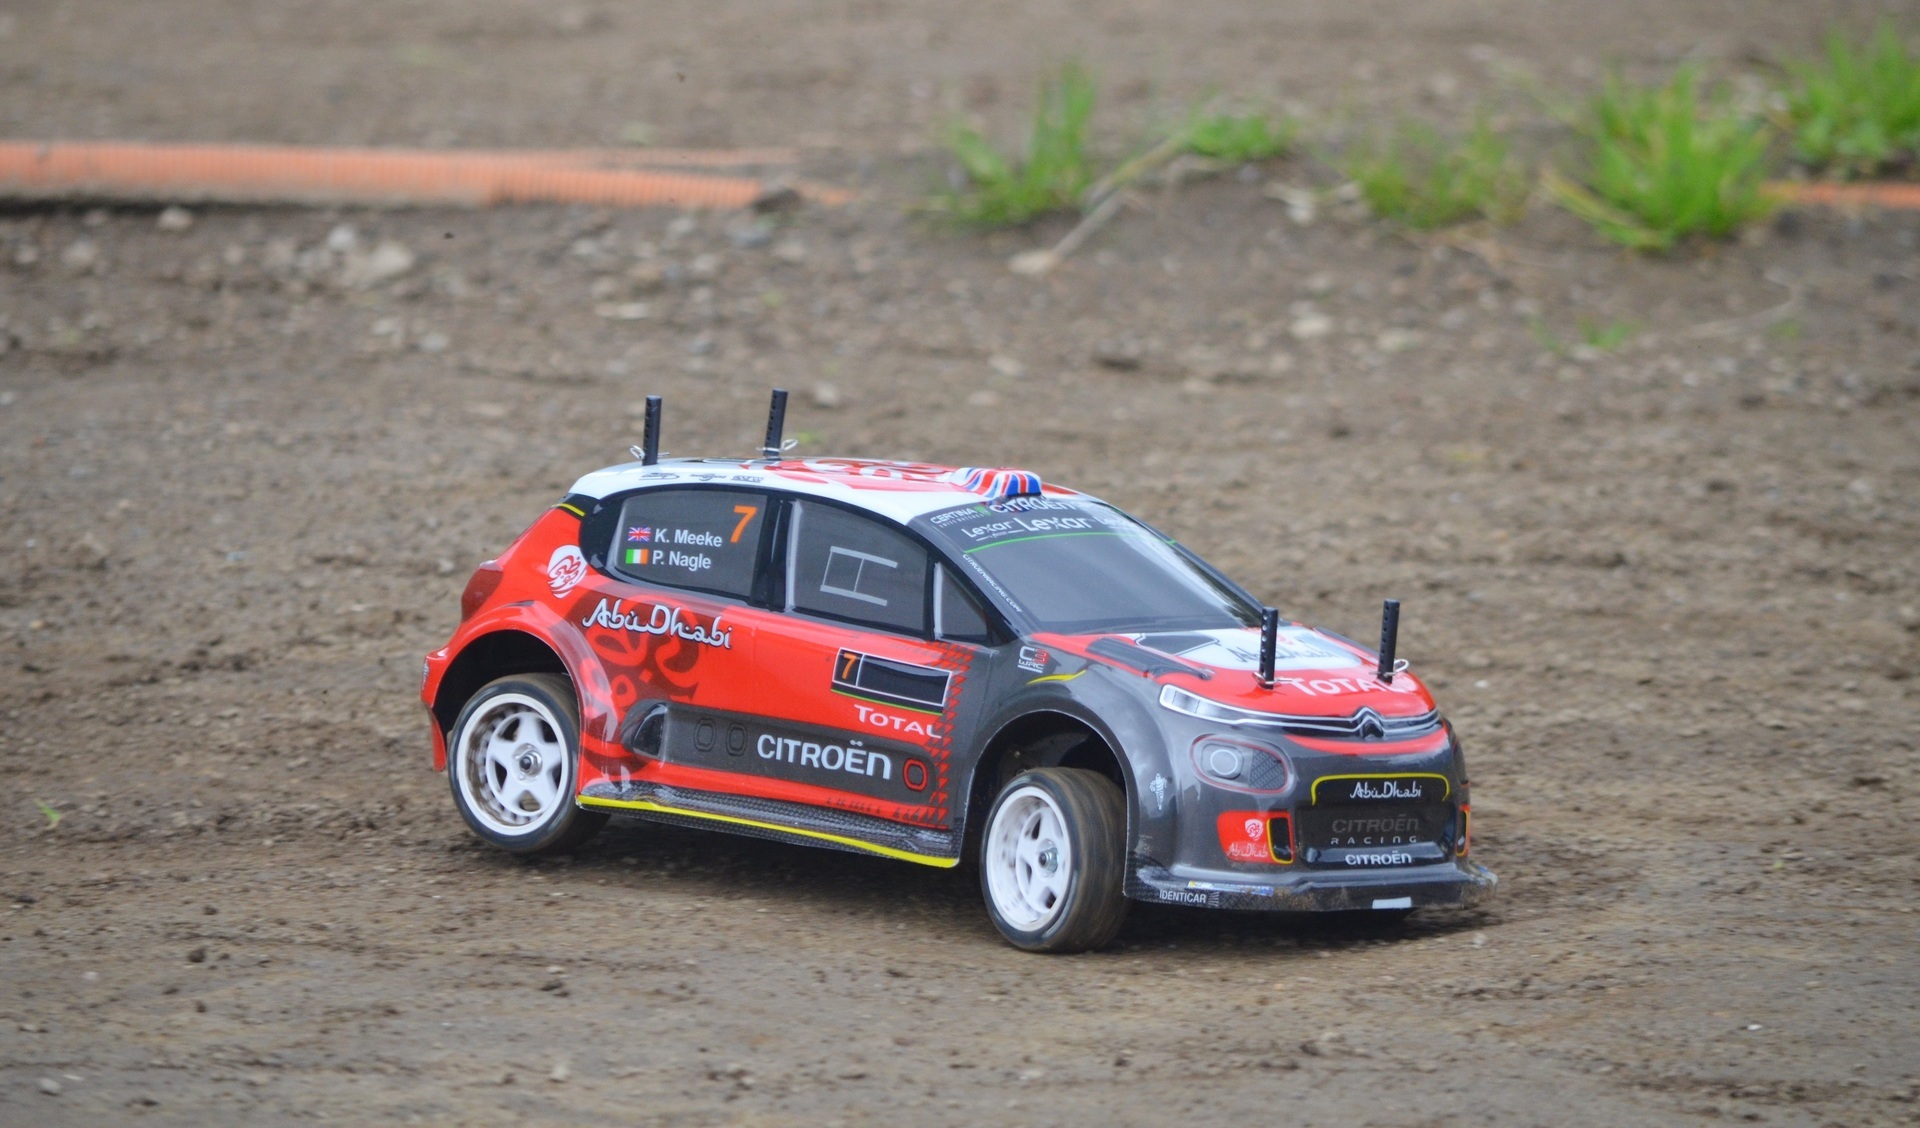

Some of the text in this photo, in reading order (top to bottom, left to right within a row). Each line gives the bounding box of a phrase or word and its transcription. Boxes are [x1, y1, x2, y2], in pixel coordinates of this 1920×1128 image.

[730, 504, 759, 544] 7
[930, 508, 977, 524] CERTINA
[1013, 517, 1092, 531] Lexar
[655, 528, 723, 548] K. Meeke
[961, 521, 1013, 538] Lexar
[652, 549, 712, 572] P. Nagle
[842, 652, 858, 681] 7
[1284, 677, 1407, 697] TOTAL
[853, 703, 943, 739] TOTAL
[1330, 835, 1418, 845] RACING
[1159, 889, 1207, 904] IDENTICAR
